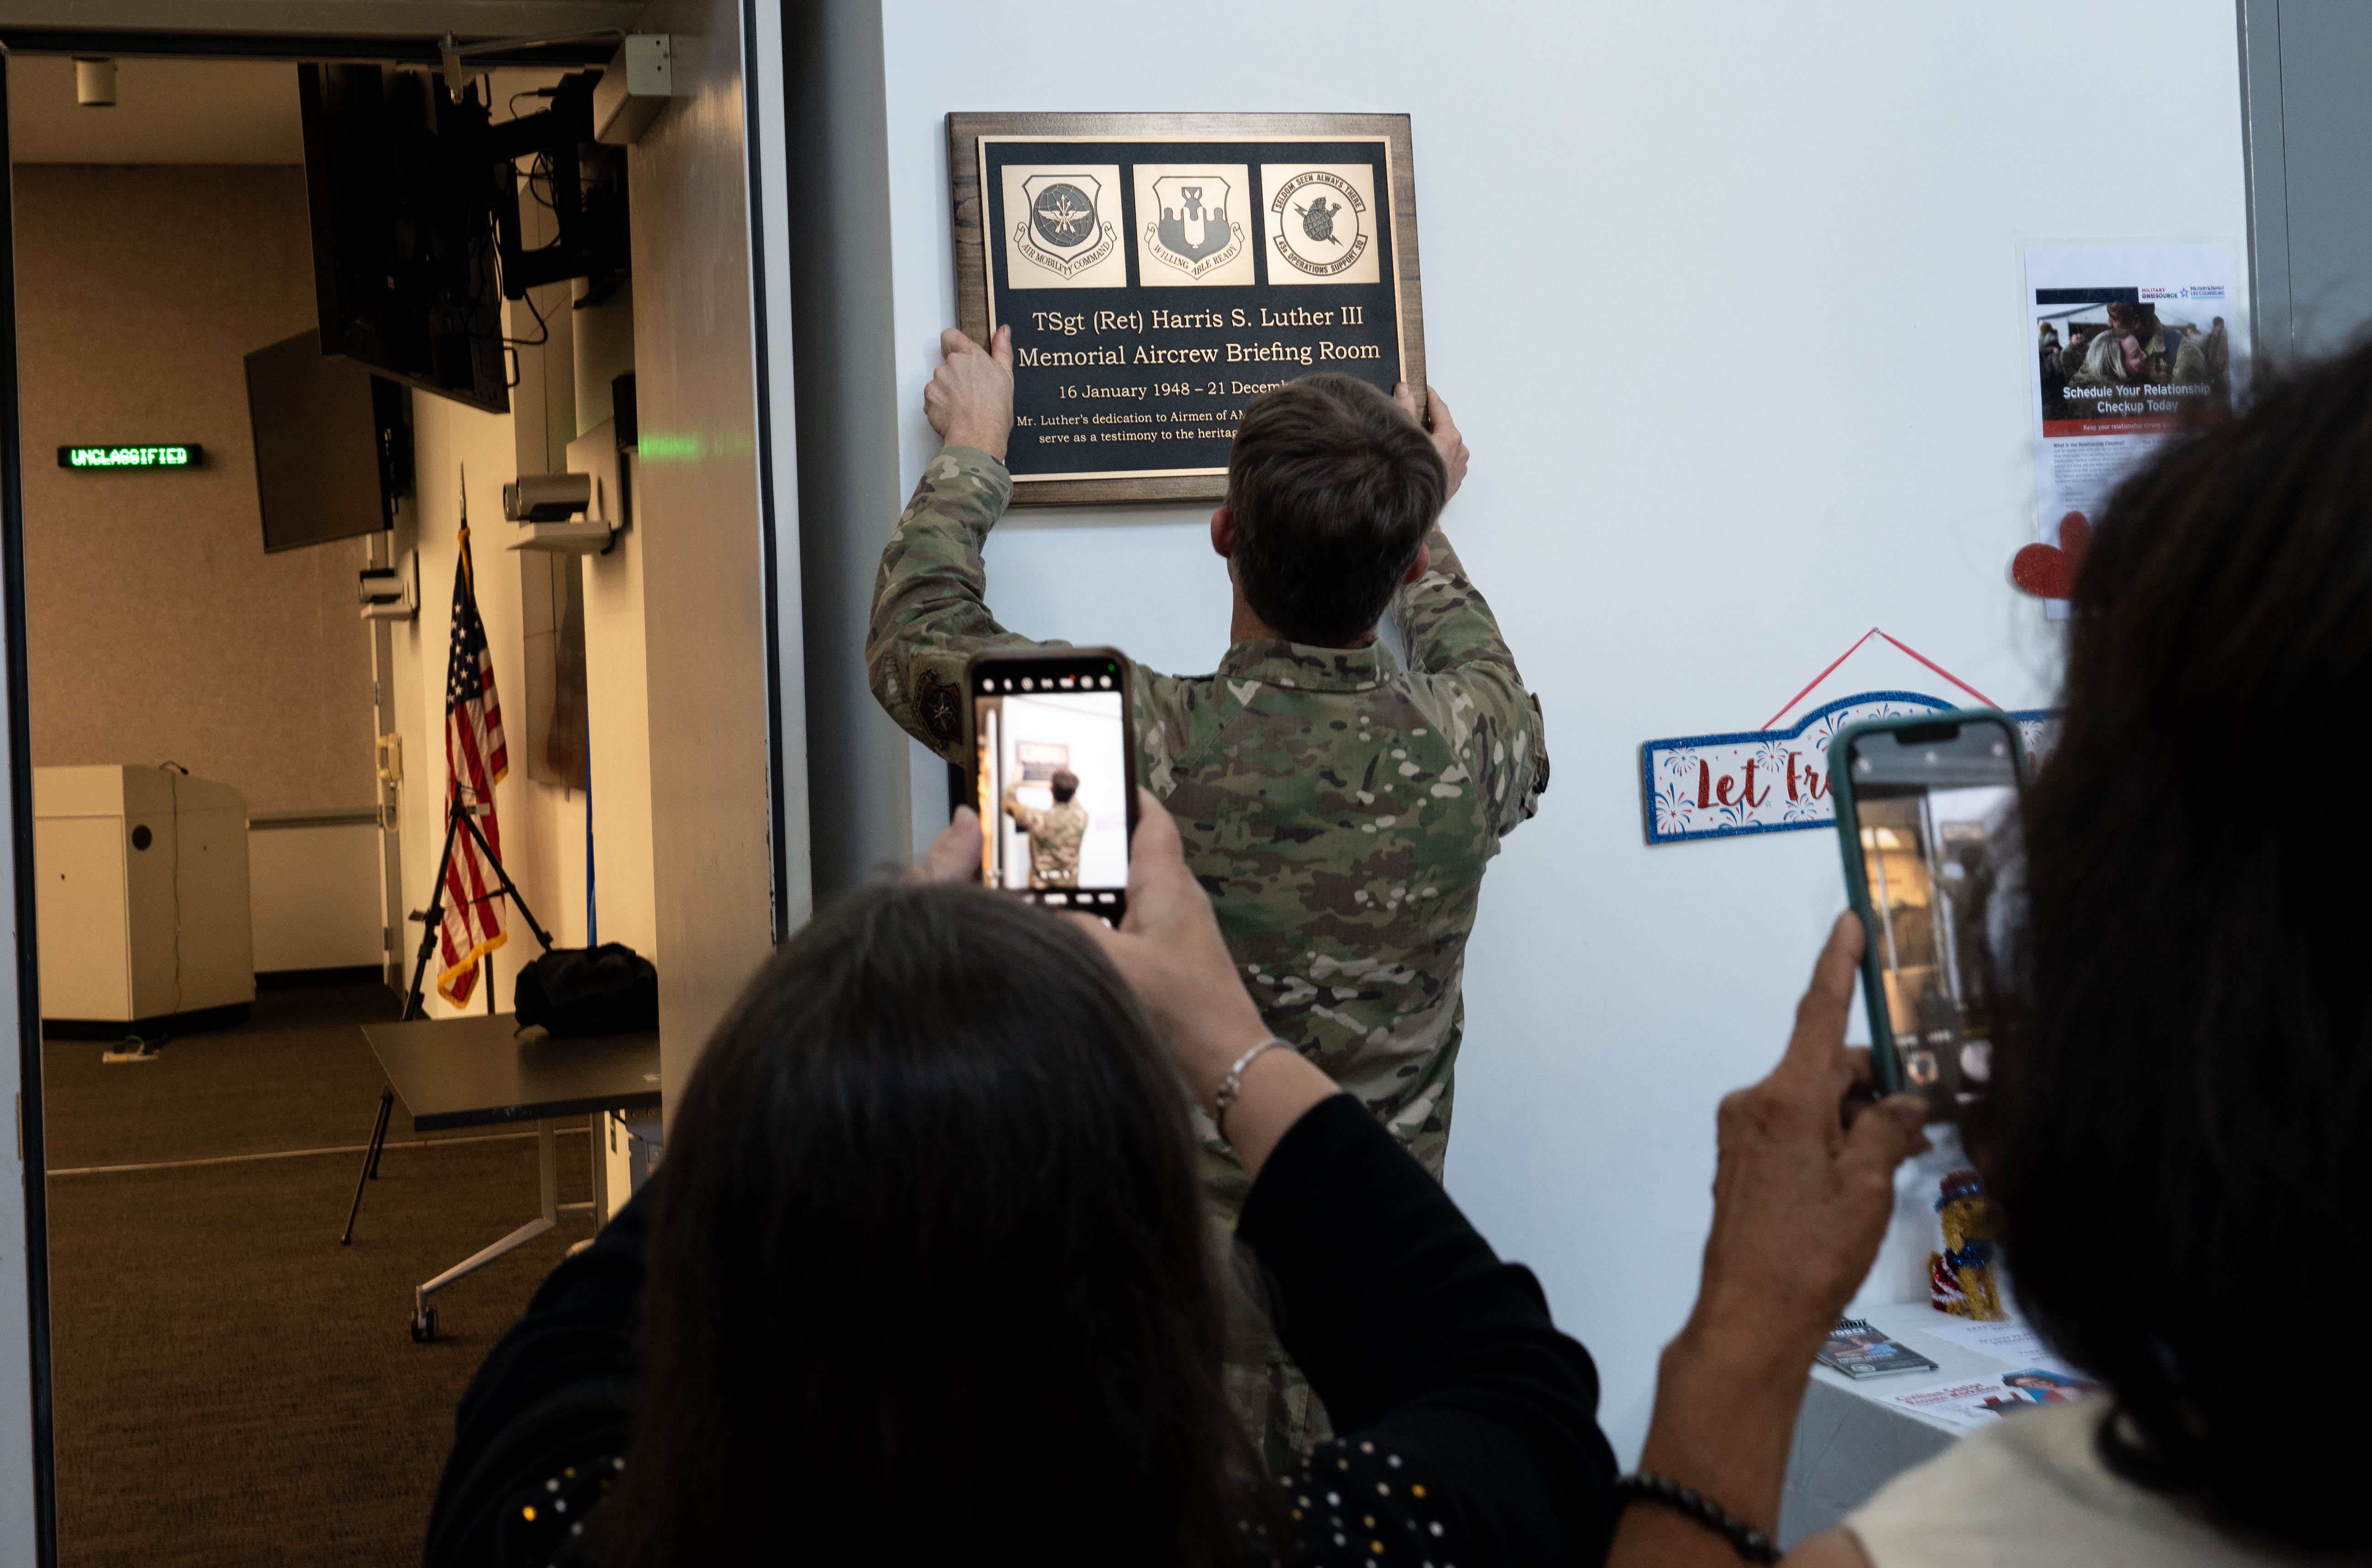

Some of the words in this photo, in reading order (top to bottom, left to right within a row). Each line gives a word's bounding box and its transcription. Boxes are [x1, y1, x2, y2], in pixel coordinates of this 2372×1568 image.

[1275, 183, 1295, 209] SELDOM
[1296, 174, 1314, 185] SEEN
[1317, 174, 1344, 189] ALWAYS
[1344, 187, 1362, 208] THERE
[1021, 244, 1035, 258] AIR
[1035, 253, 1073, 275] MOBILITY
[1074, 242, 1109, 269] COMMAND
[1154, 244, 1189, 269] WILLING
[1191, 260, 1211, 275] ABLE
[1213, 244, 1237, 265] READY
[1288, 253, 1328, 273] OPERATIONS
[1331, 250, 1358, 272] SUPPORT
[1355, 240, 1364, 250] SQ
[1032, 311, 1085, 336] TSgt
[1094, 310, 1143, 335] (Ret)
[1152, 309, 1223, 329] Harris
[1231, 308, 1252, 327] S.
[1260, 307, 1334, 327] Luther
[1341, 306, 1363, 326] III
[1018, 345, 1126, 367] Memorial
[1133, 344, 1219, 364] Aircrew
[1226, 342, 1313, 366] Briefing
[1319, 341, 1380, 360] Room
[1060, 385, 1077, 399] 16
[1082, 385, 1147, 400] January
[1154, 383, 1190, 396] 1948
[1208, 381, 1225, 395] 21
[2063, 386, 2113, 399] Schedule
[2115, 385, 2140, 397] Your
[2144, 383, 2210, 396] Relationship
[1017, 416, 1036, 426] Mr.
[1041, 414, 1088, 426] Luther’s
[1092, 413, 1152, 424] dedication
[1156, 413, 1167, 422] to
[1170, 411, 1213, 422] Airmen
[1216, 410, 1227, 420] of
[2097, 401, 2144, 413] Checkup
[2146, 400, 2178, 412] Today
[1039, 434, 1069, 443] serve
[1101, 431, 1157, 443] testimony
[1161, 430, 1172, 440] to
[1176, 428, 1194, 439] the
[71, 448, 187, 466] UNCLASSIFIED
[1697, 757, 1770, 808] Let
